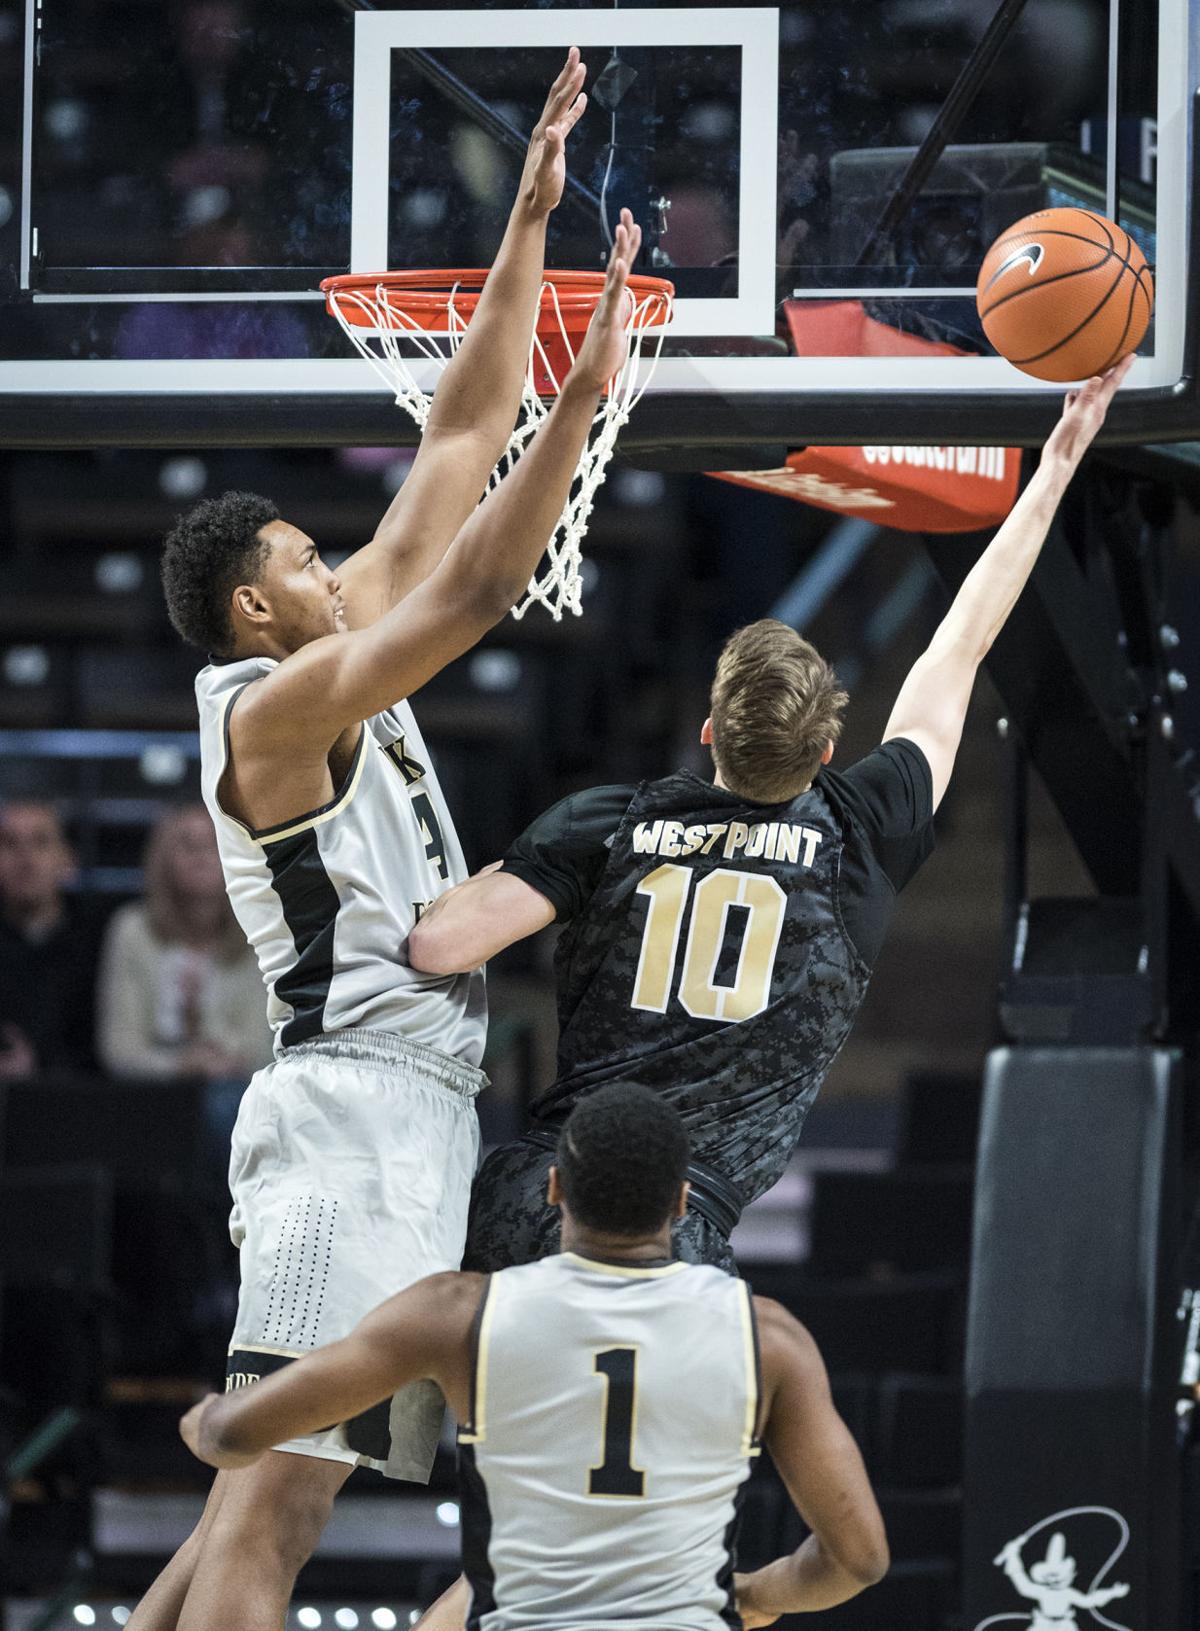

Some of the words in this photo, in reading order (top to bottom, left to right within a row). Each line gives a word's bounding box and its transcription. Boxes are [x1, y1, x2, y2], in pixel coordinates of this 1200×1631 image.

[633, 820, 728, 857] WEST
[722, 821, 823, 868] POINT
[630, 862, 788, 1023] 10
[586, 1344, 646, 1497] 1
